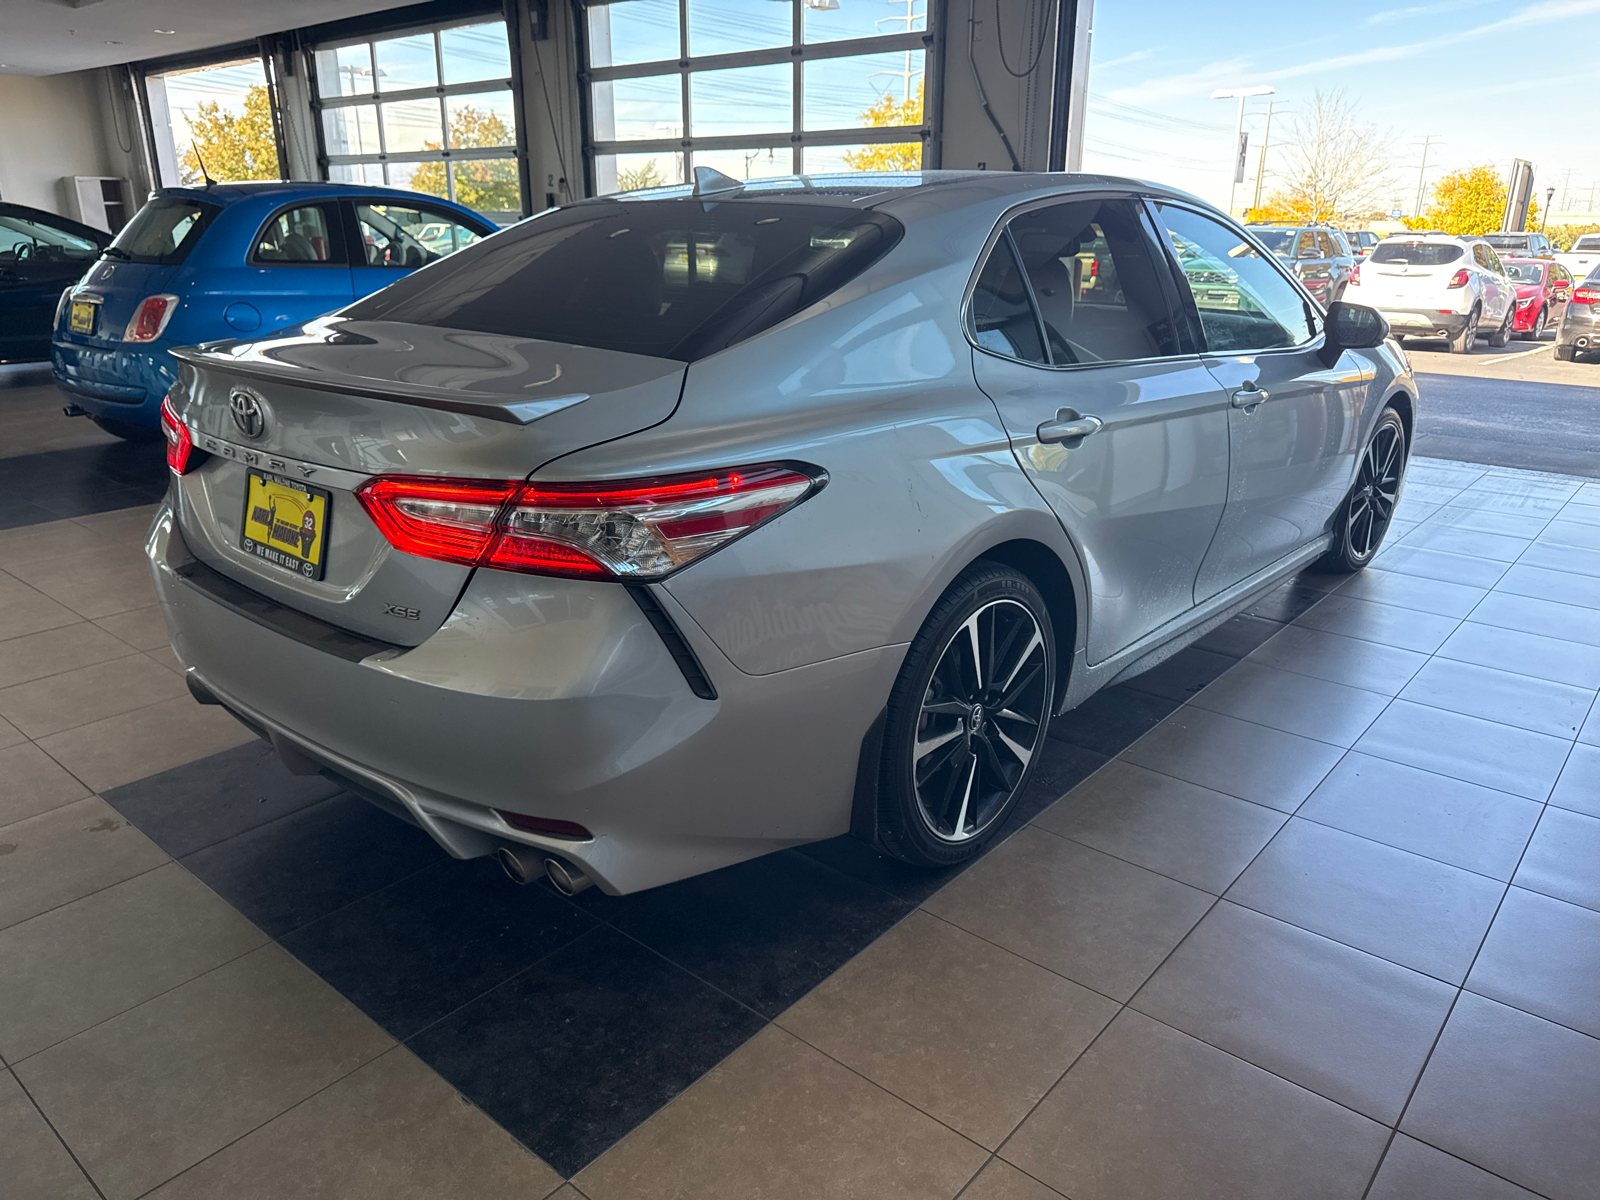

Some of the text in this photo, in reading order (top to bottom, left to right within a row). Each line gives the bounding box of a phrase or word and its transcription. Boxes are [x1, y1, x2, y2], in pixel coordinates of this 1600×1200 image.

[547, 174, 554, 187] 2
[204, 439, 318, 478] CAMRY
[251, 505, 271, 527] KARL
[304, 516, 313, 530] 32
[271, 523, 300, 548] MALONE
[256, 544, 299, 571] WE MAKE IT EASY
[381, 602, 421, 621] XSE
